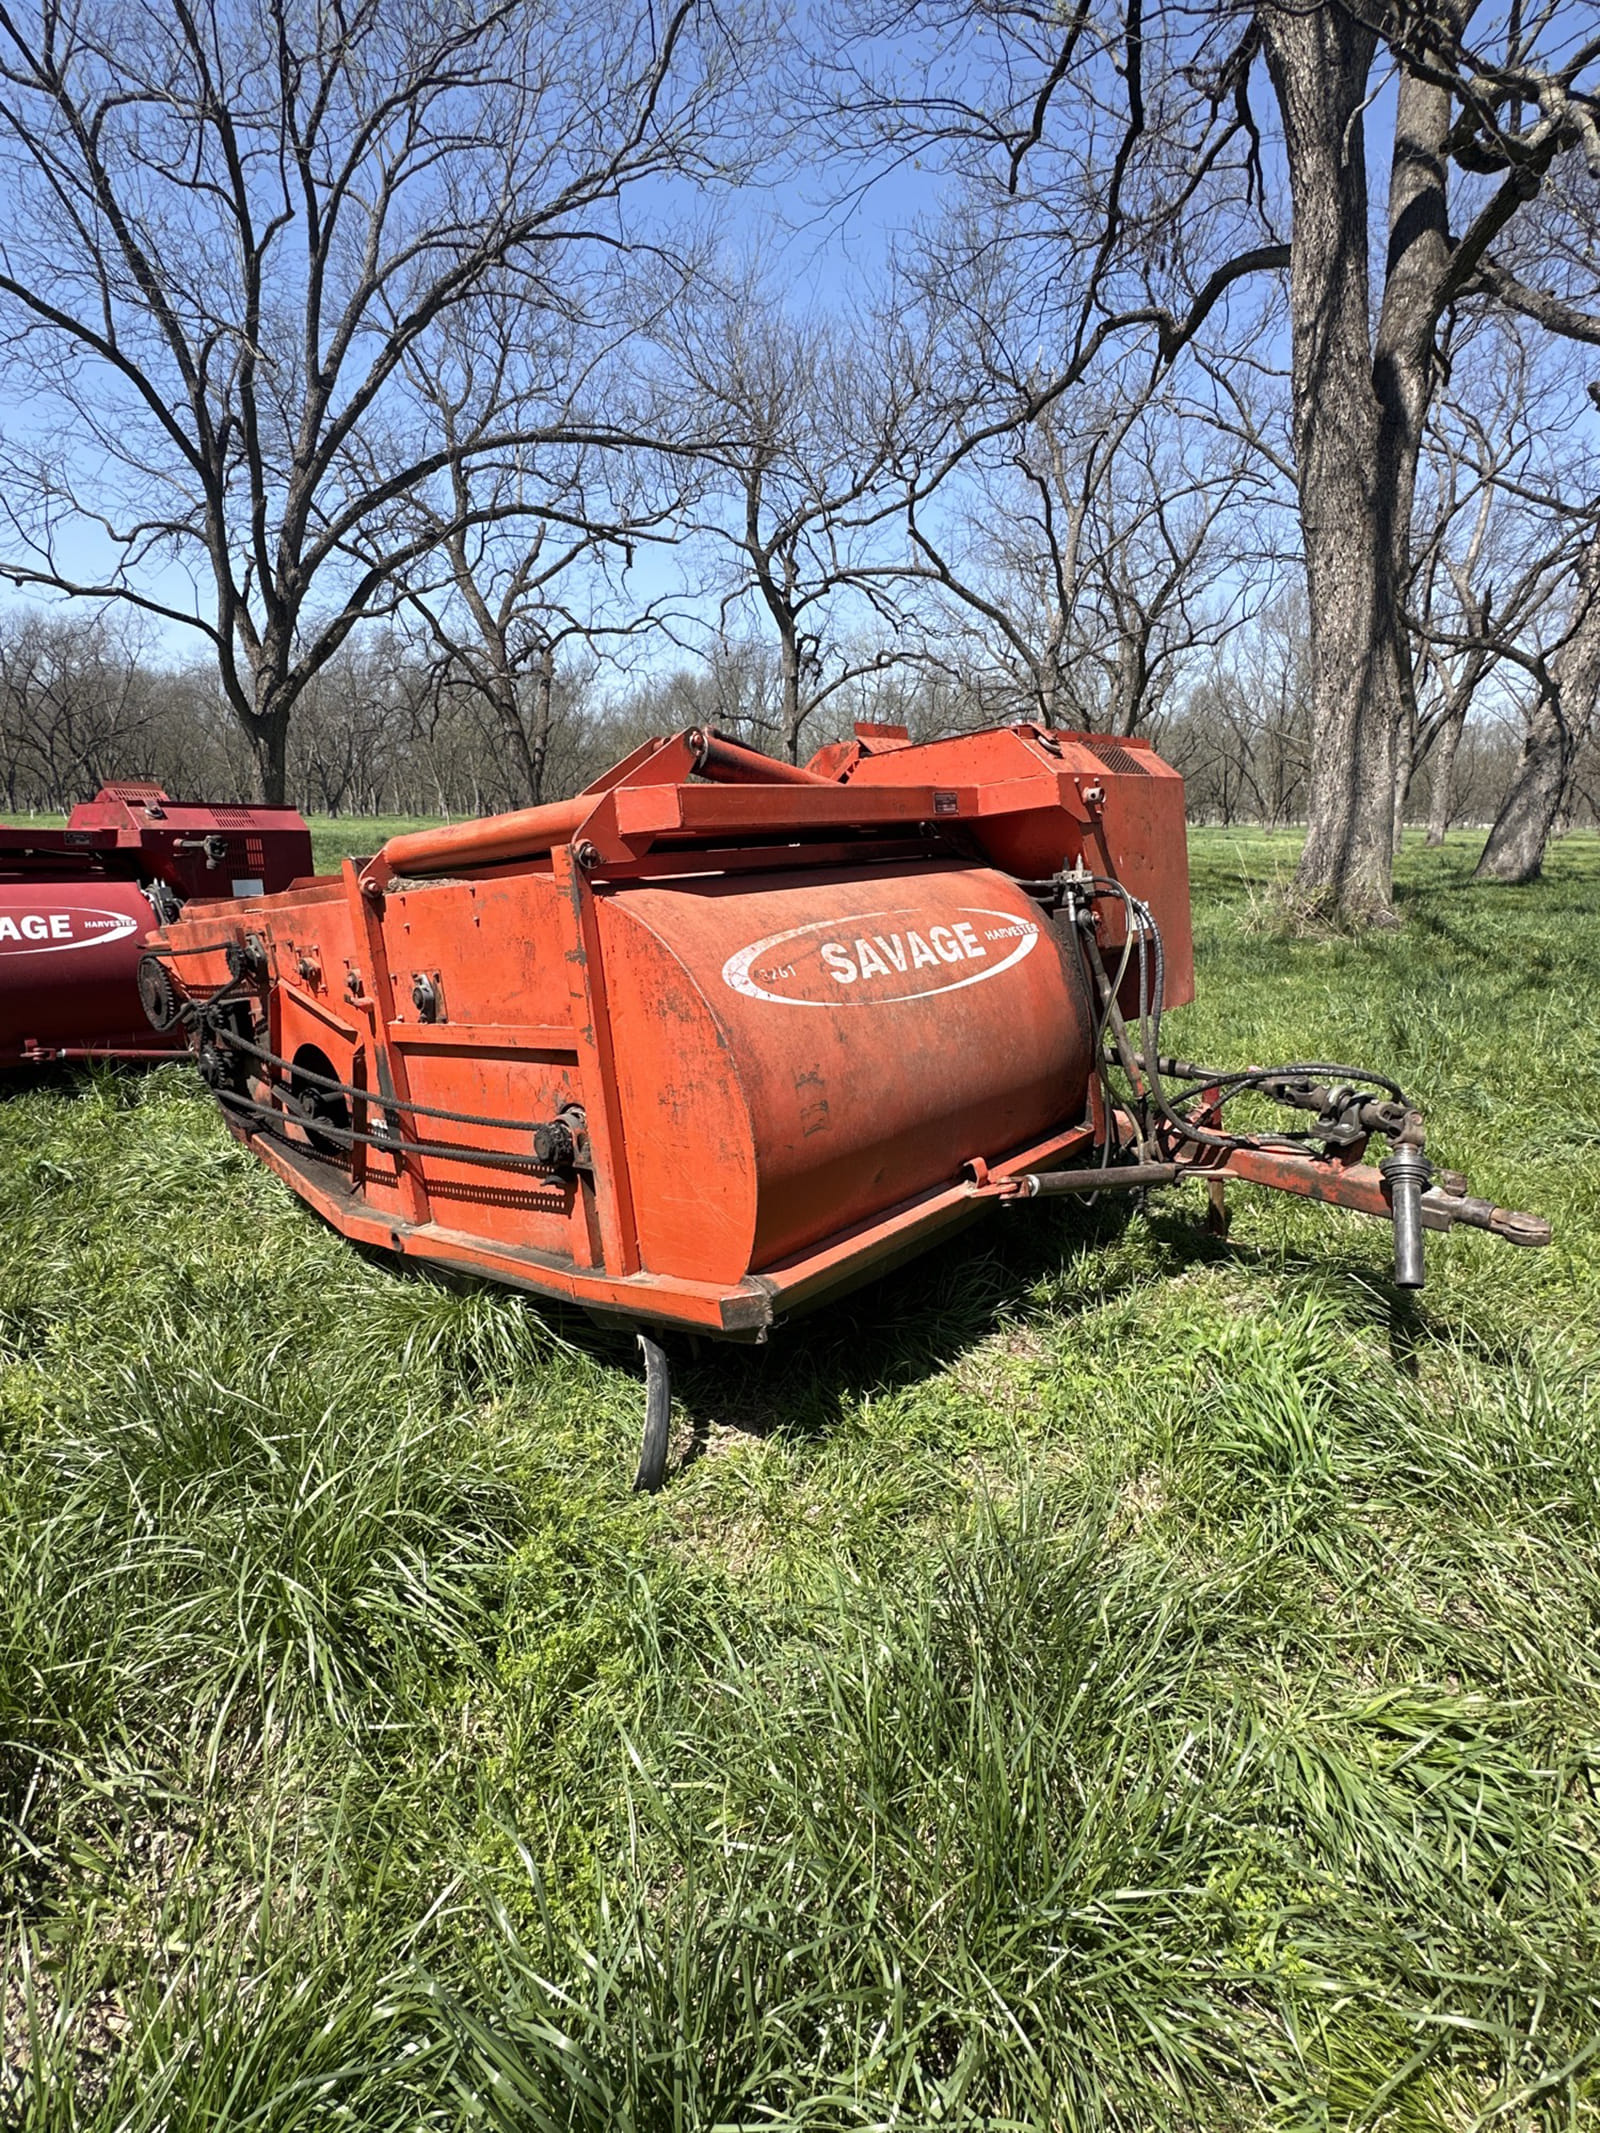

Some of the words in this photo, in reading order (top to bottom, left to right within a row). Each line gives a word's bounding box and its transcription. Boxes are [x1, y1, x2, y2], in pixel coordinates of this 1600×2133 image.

[84, 920, 137, 928] HARVESTER
[821, 922, 986, 983] SAVAGE
[984, 923, 1040, 940] HARVESTER
